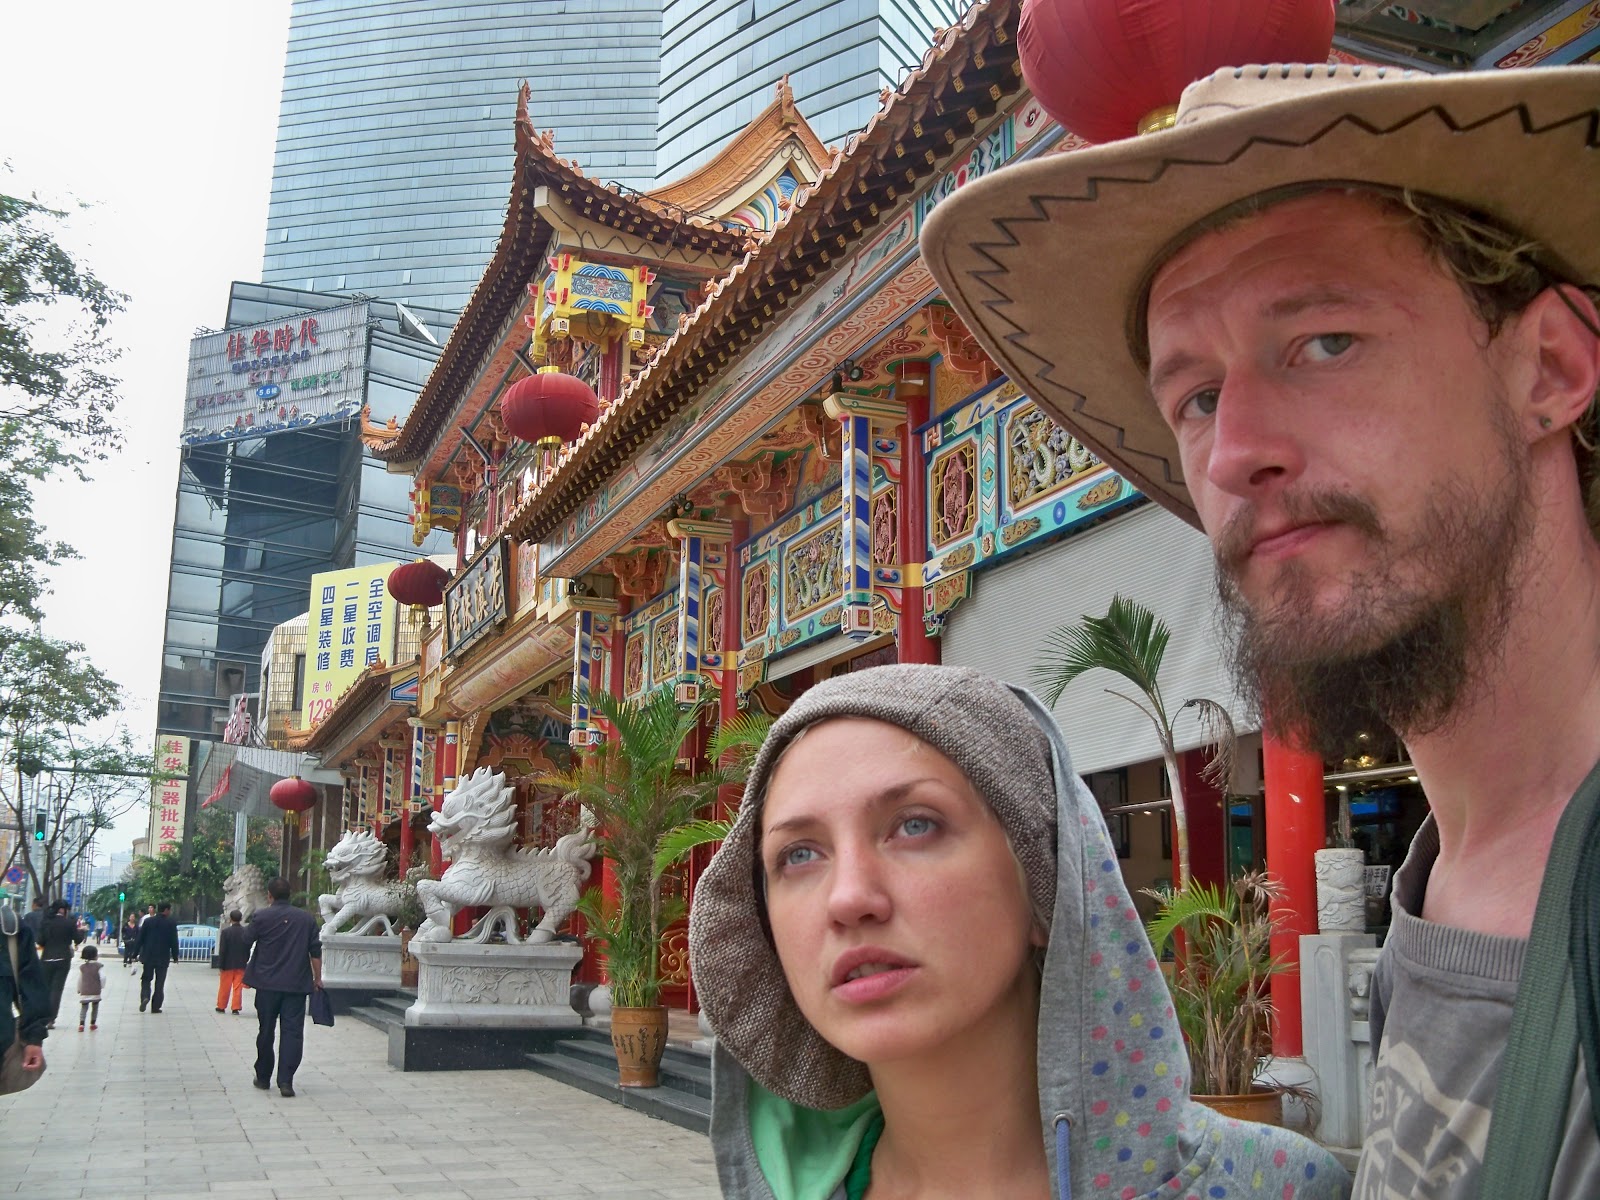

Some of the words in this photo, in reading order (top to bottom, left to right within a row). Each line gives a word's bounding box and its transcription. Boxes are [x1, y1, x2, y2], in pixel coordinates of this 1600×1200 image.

[248, 365, 291, 385] KTV
[317, 585, 336, 671] 四星装修
[340, 581, 360, 668] 二星收费
[365, 578, 384, 666] 全空调房
[308, 698, 333, 722] 128
[311, 680, 332, 693] 房价
